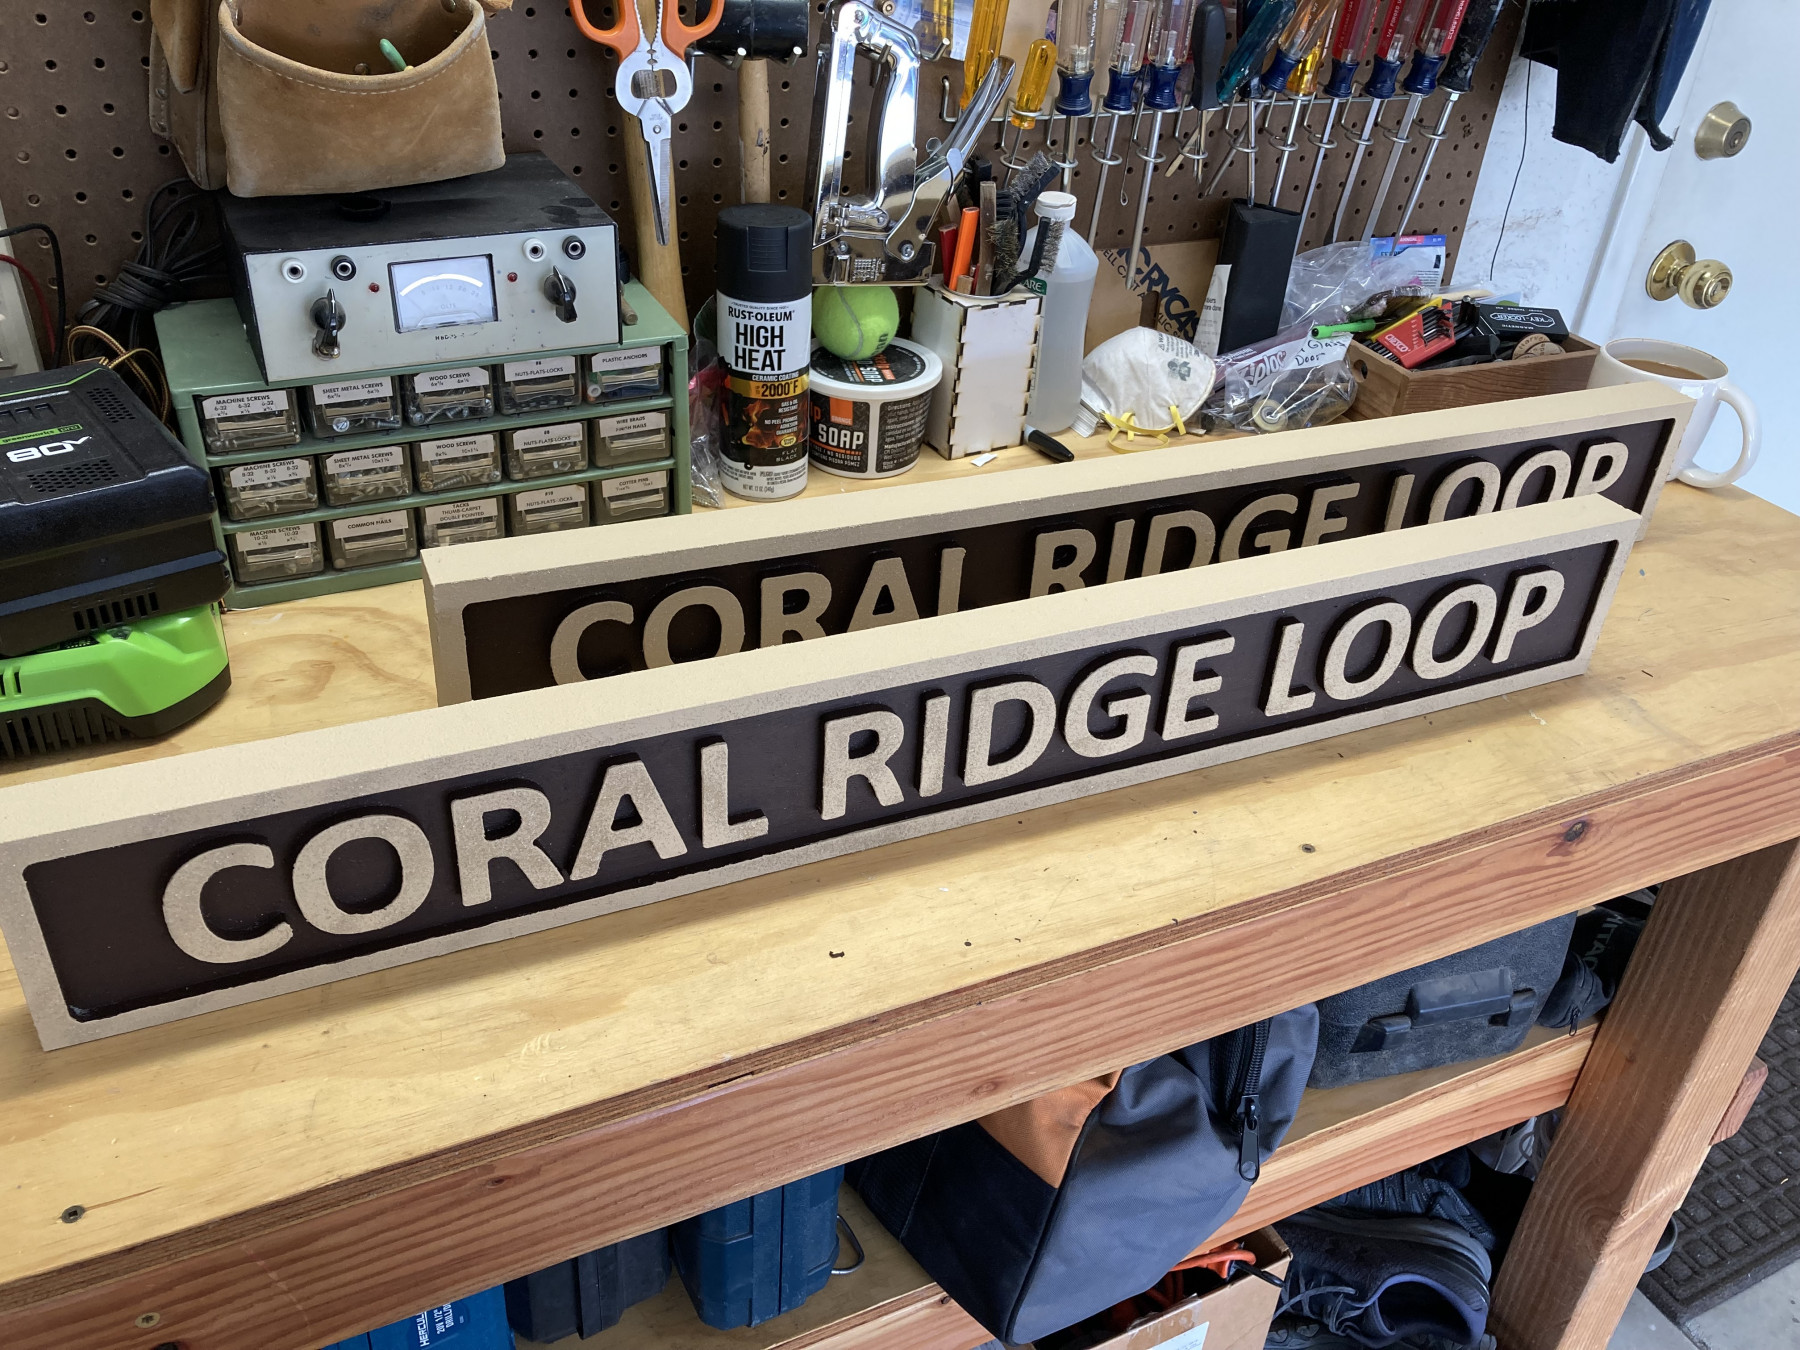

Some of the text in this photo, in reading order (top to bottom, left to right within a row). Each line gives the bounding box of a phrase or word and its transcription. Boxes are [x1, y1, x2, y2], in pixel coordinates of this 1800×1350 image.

[728, 305, 793, 322] RUST-OLEUM
[735, 321, 784, 348] HIGH
[602, 353, 648, 364] PLASTIC ANCHORS
[734, 345, 786, 372] HEAT
[1295, 352, 1325, 367] Door
[752, 371, 799, 382] CERAMIC COATING
[215, 394, 271, 405] MACHINE SCREWS
[2, 429, 55, 444] greenworks
[818, 423, 865, 450] SOAP
[6, 435, 93, 463] 80V
[782, 447, 798, 456] FLAT
[333, 456, 350, 464] SHEET
[371, 451, 393, 459] SCREWS
[243, 460, 295, 472] MACHINE SCREWS
[440, 511, 485, 522] DOUBLE POINTED
[249, 525, 301, 537] MACHINE SCREWS
[347, 518, 392, 530] COMMON NAILS
[549, 545, 967, 687] CORAL
[1028, 481, 1362, 600] RIDGE
[160, 568, 1566, 965] CORAL RIDGE LOOP
